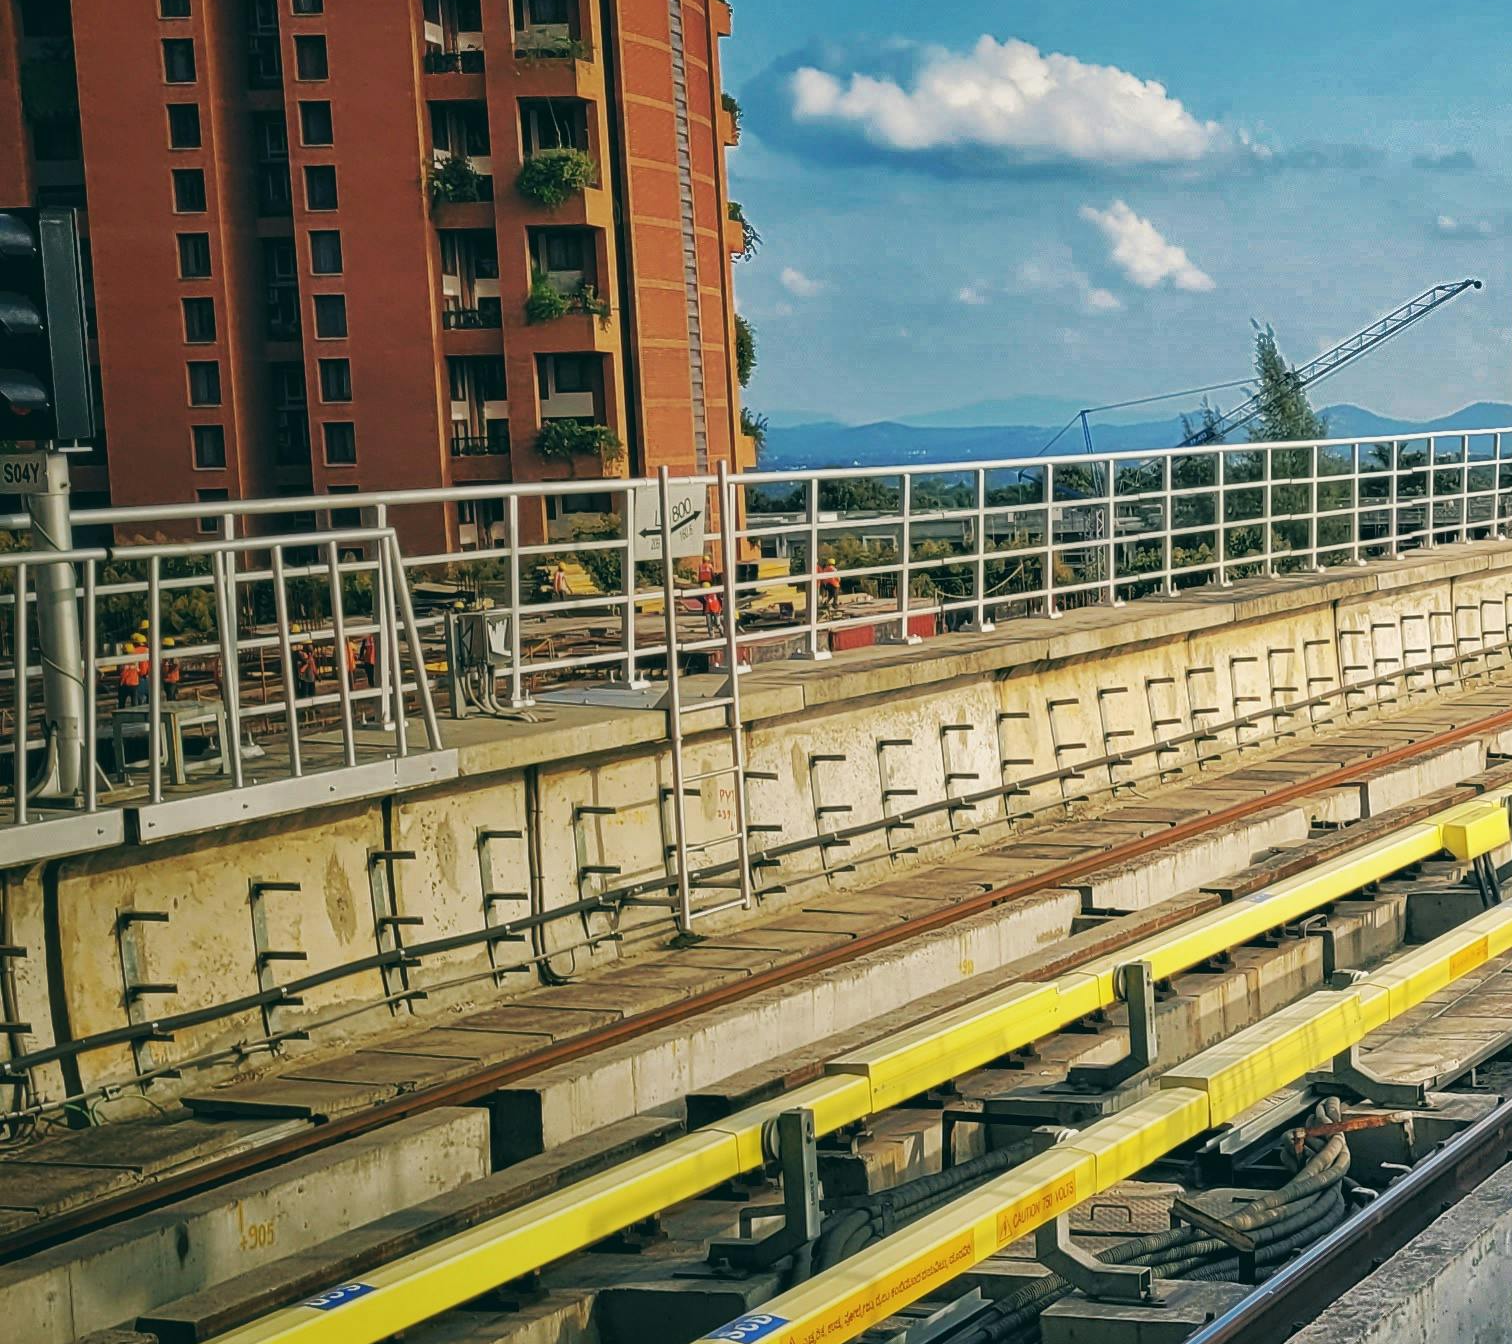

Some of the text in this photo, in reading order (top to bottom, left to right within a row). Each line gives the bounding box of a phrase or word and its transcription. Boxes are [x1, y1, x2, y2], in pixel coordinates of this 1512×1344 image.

[3, 462, 40, 484] S04Y
[671, 497, 692, 523] 800
[1013, 1200, 1041, 1229] CAUTION
[1055, 1181, 1074, 1202] VOLTS
